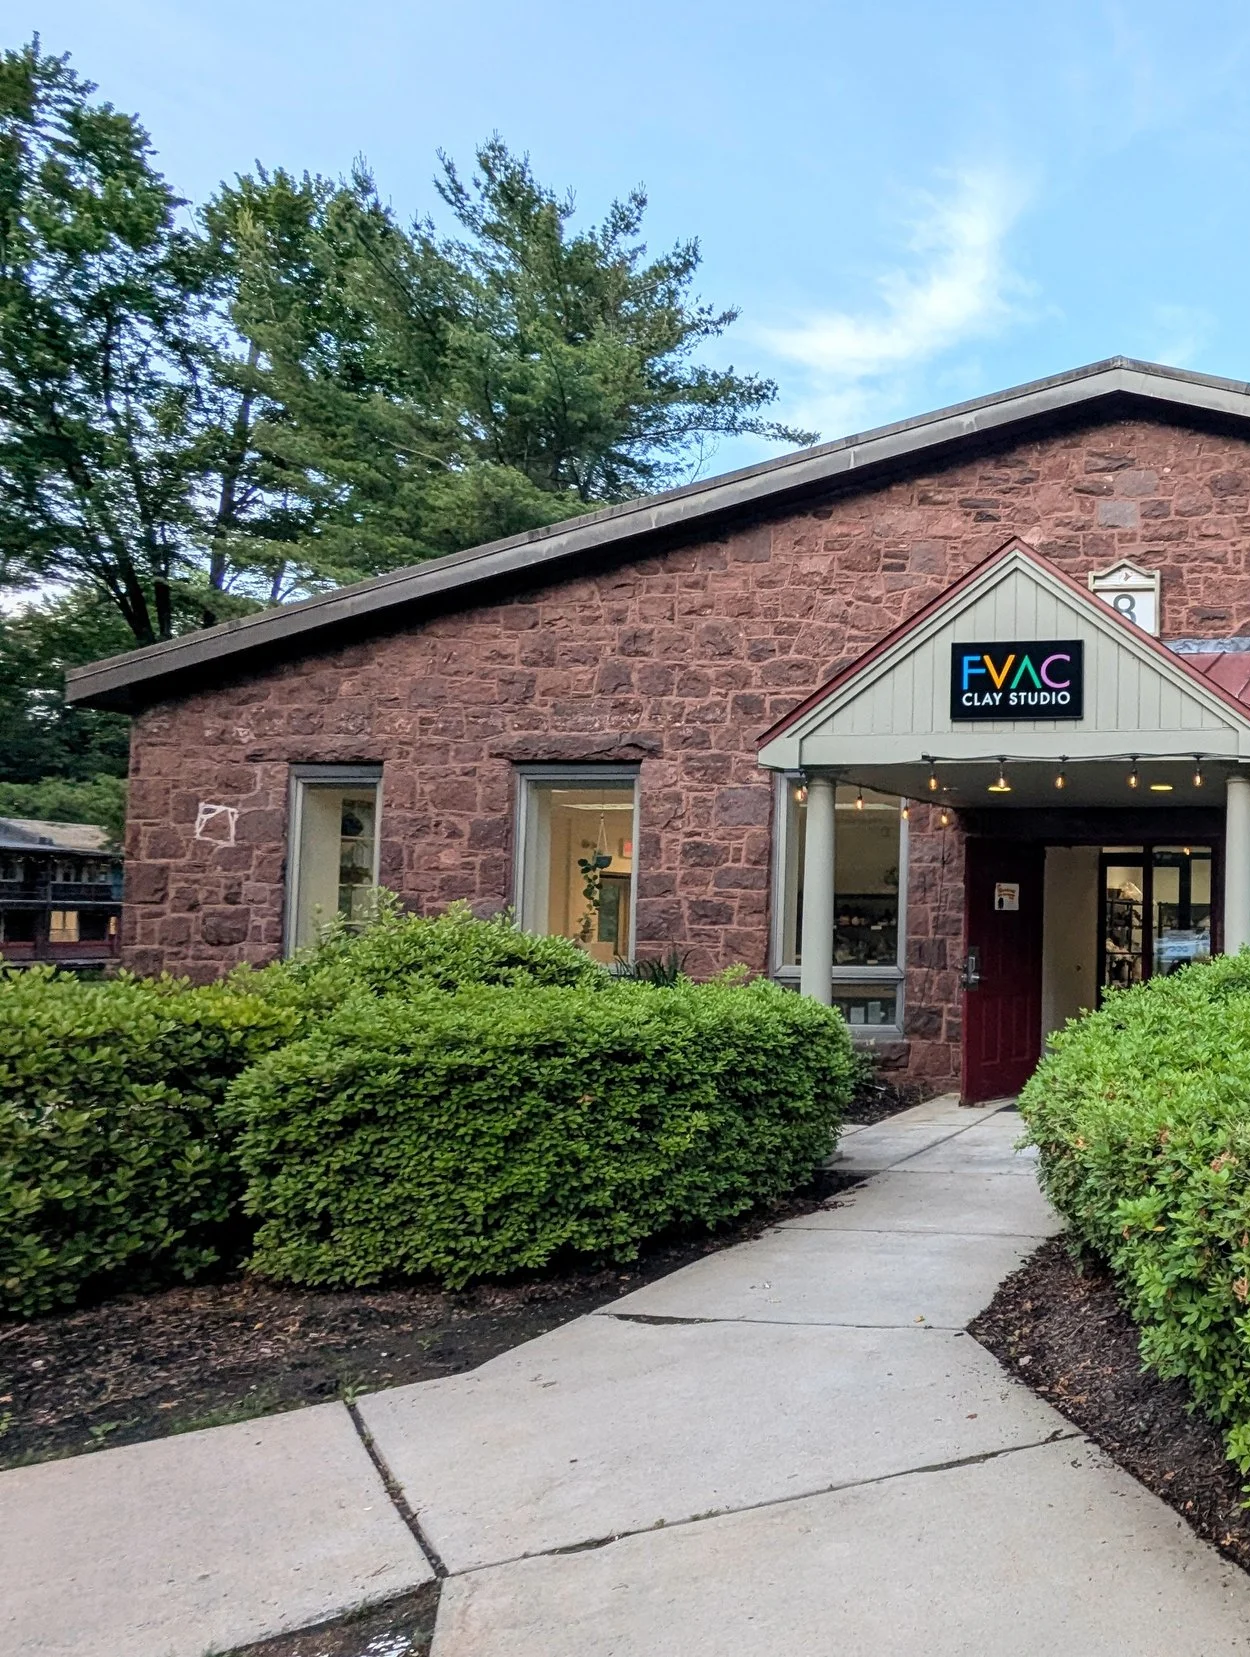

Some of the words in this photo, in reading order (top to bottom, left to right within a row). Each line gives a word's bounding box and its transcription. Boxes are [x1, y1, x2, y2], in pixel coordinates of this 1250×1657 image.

[962, 654, 1071, 690] FVAC
[962, 692, 1002, 706] CLAY
[1009, 691, 1071, 705] STUDIO
